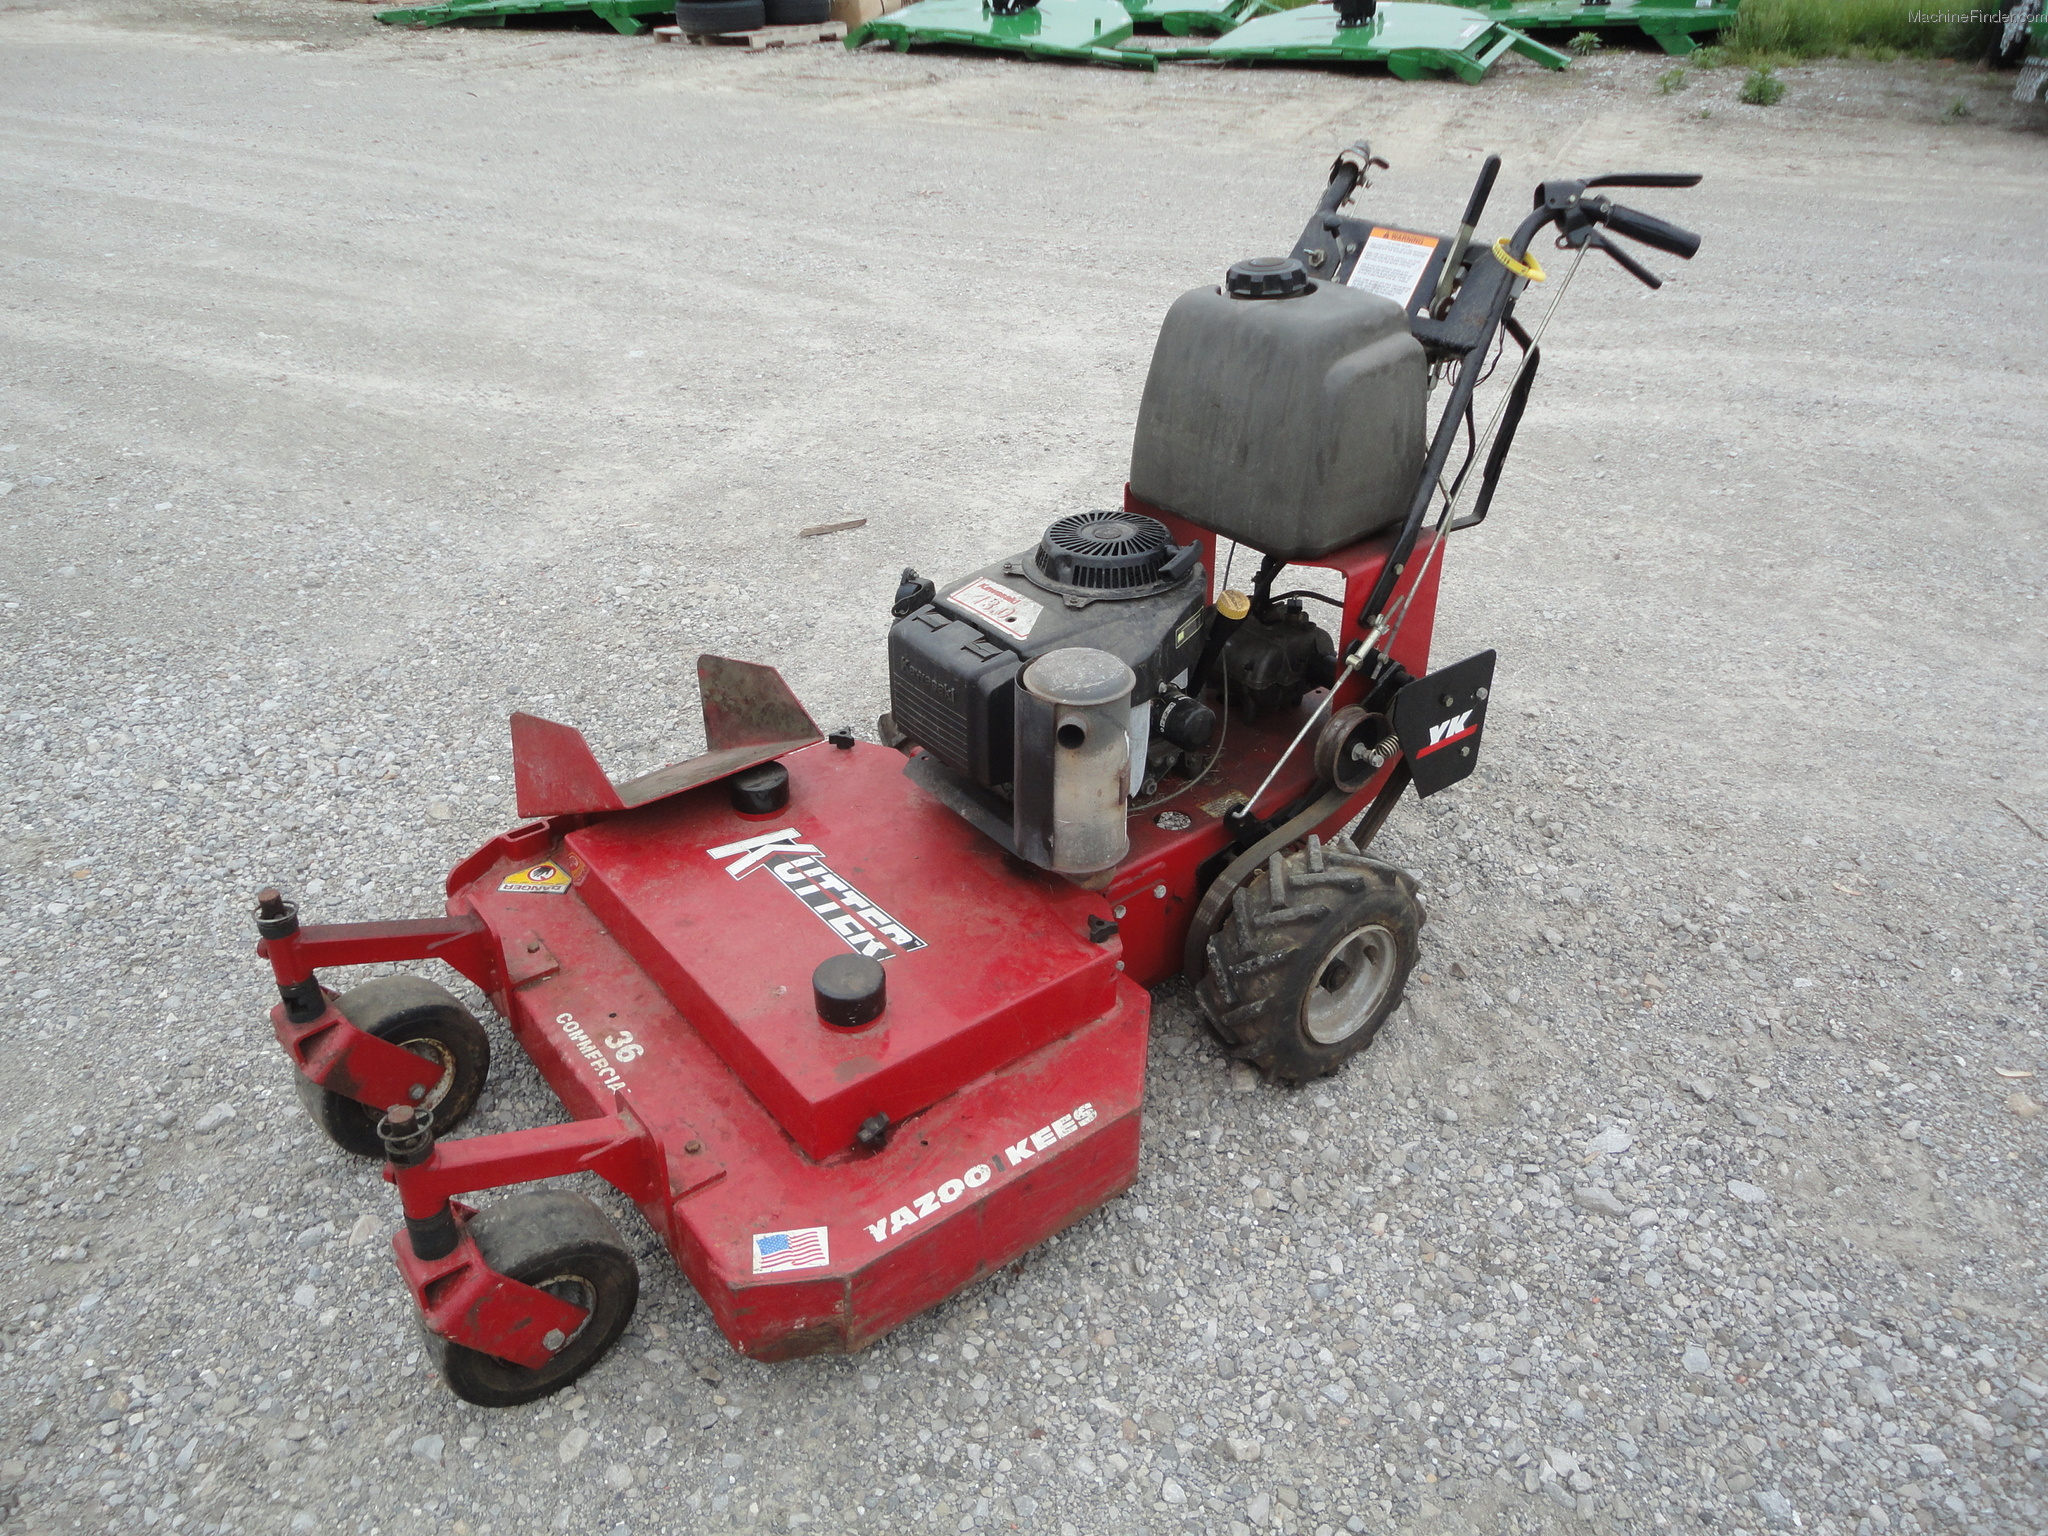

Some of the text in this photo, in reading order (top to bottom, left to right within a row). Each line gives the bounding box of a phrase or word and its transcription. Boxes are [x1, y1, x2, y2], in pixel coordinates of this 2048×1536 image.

[1391, 233, 1424, 245] WARNING
[900, 655, 955, 703] Kawasaki
[1429, 708, 1473, 746] YK
[556, 1012, 632, 1094] COMMERCIA
[604, 1030, 645, 1063] 36
[863, 1102, 1097, 1243] YAZOO KEES
